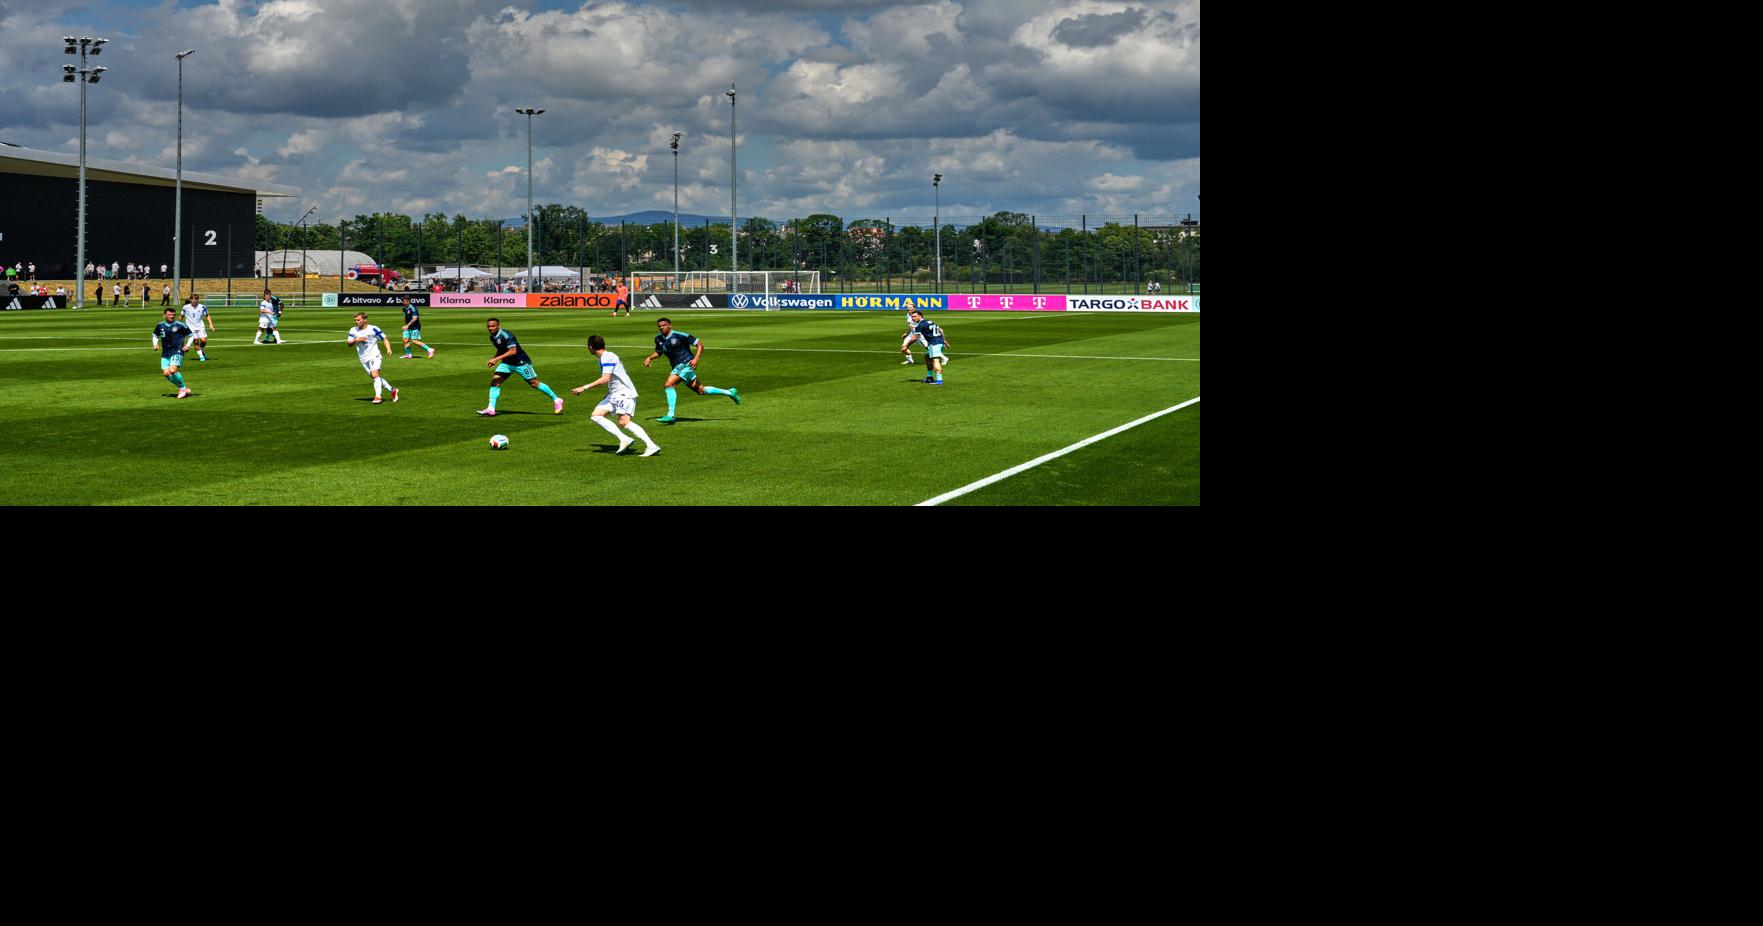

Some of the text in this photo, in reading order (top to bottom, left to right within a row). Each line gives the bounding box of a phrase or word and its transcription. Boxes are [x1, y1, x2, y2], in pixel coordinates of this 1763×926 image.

[205, 230, 216, 245] 2
[710, 245, 717, 254] 3
[540, 294, 611, 307] zalando
[752, 296, 833, 309] Volkswagen
[841, 296, 942, 308] HÖRMANN
[967, 296, 1047, 308] T T T
